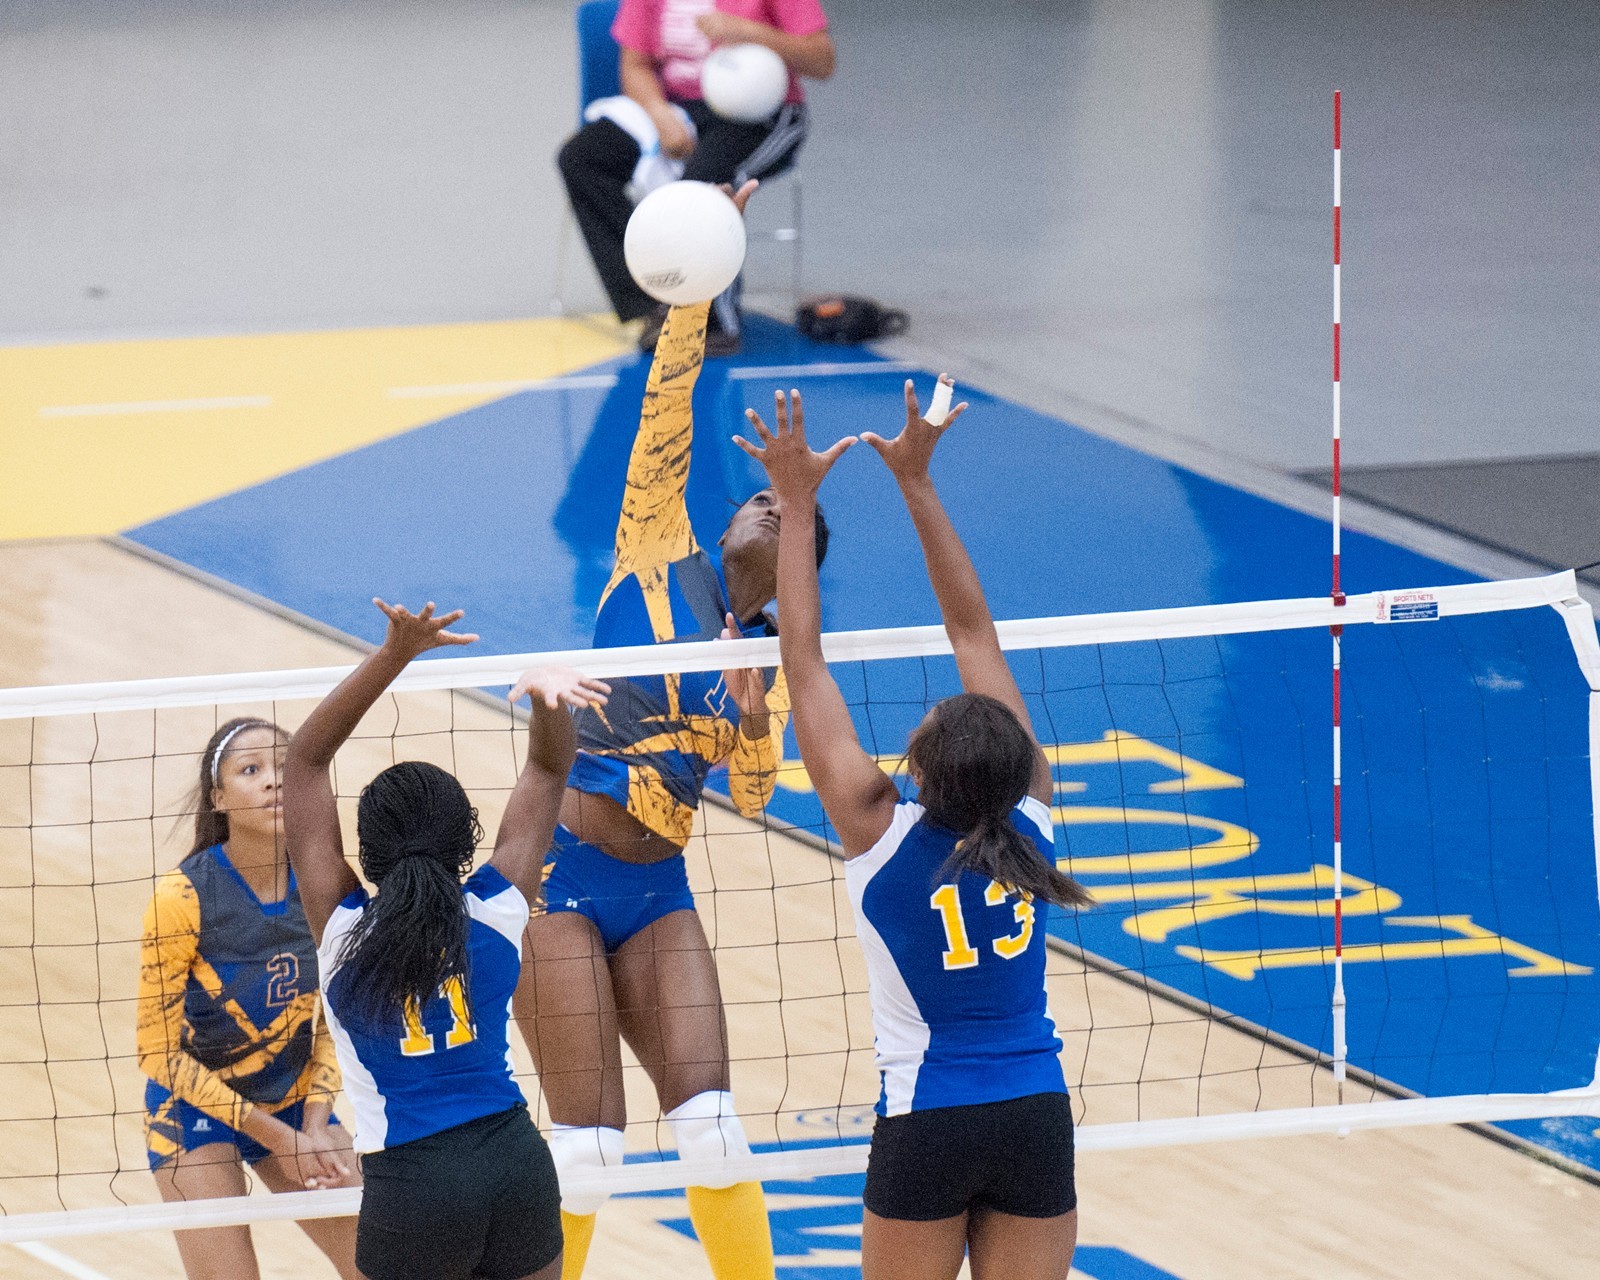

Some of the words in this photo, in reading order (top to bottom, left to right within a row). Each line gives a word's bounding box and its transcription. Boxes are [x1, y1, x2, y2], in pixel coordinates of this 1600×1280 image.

[930, 879, 1035, 970] 13
[266, 952, 300, 1007] 2
[400, 972, 477, 1056] 11
